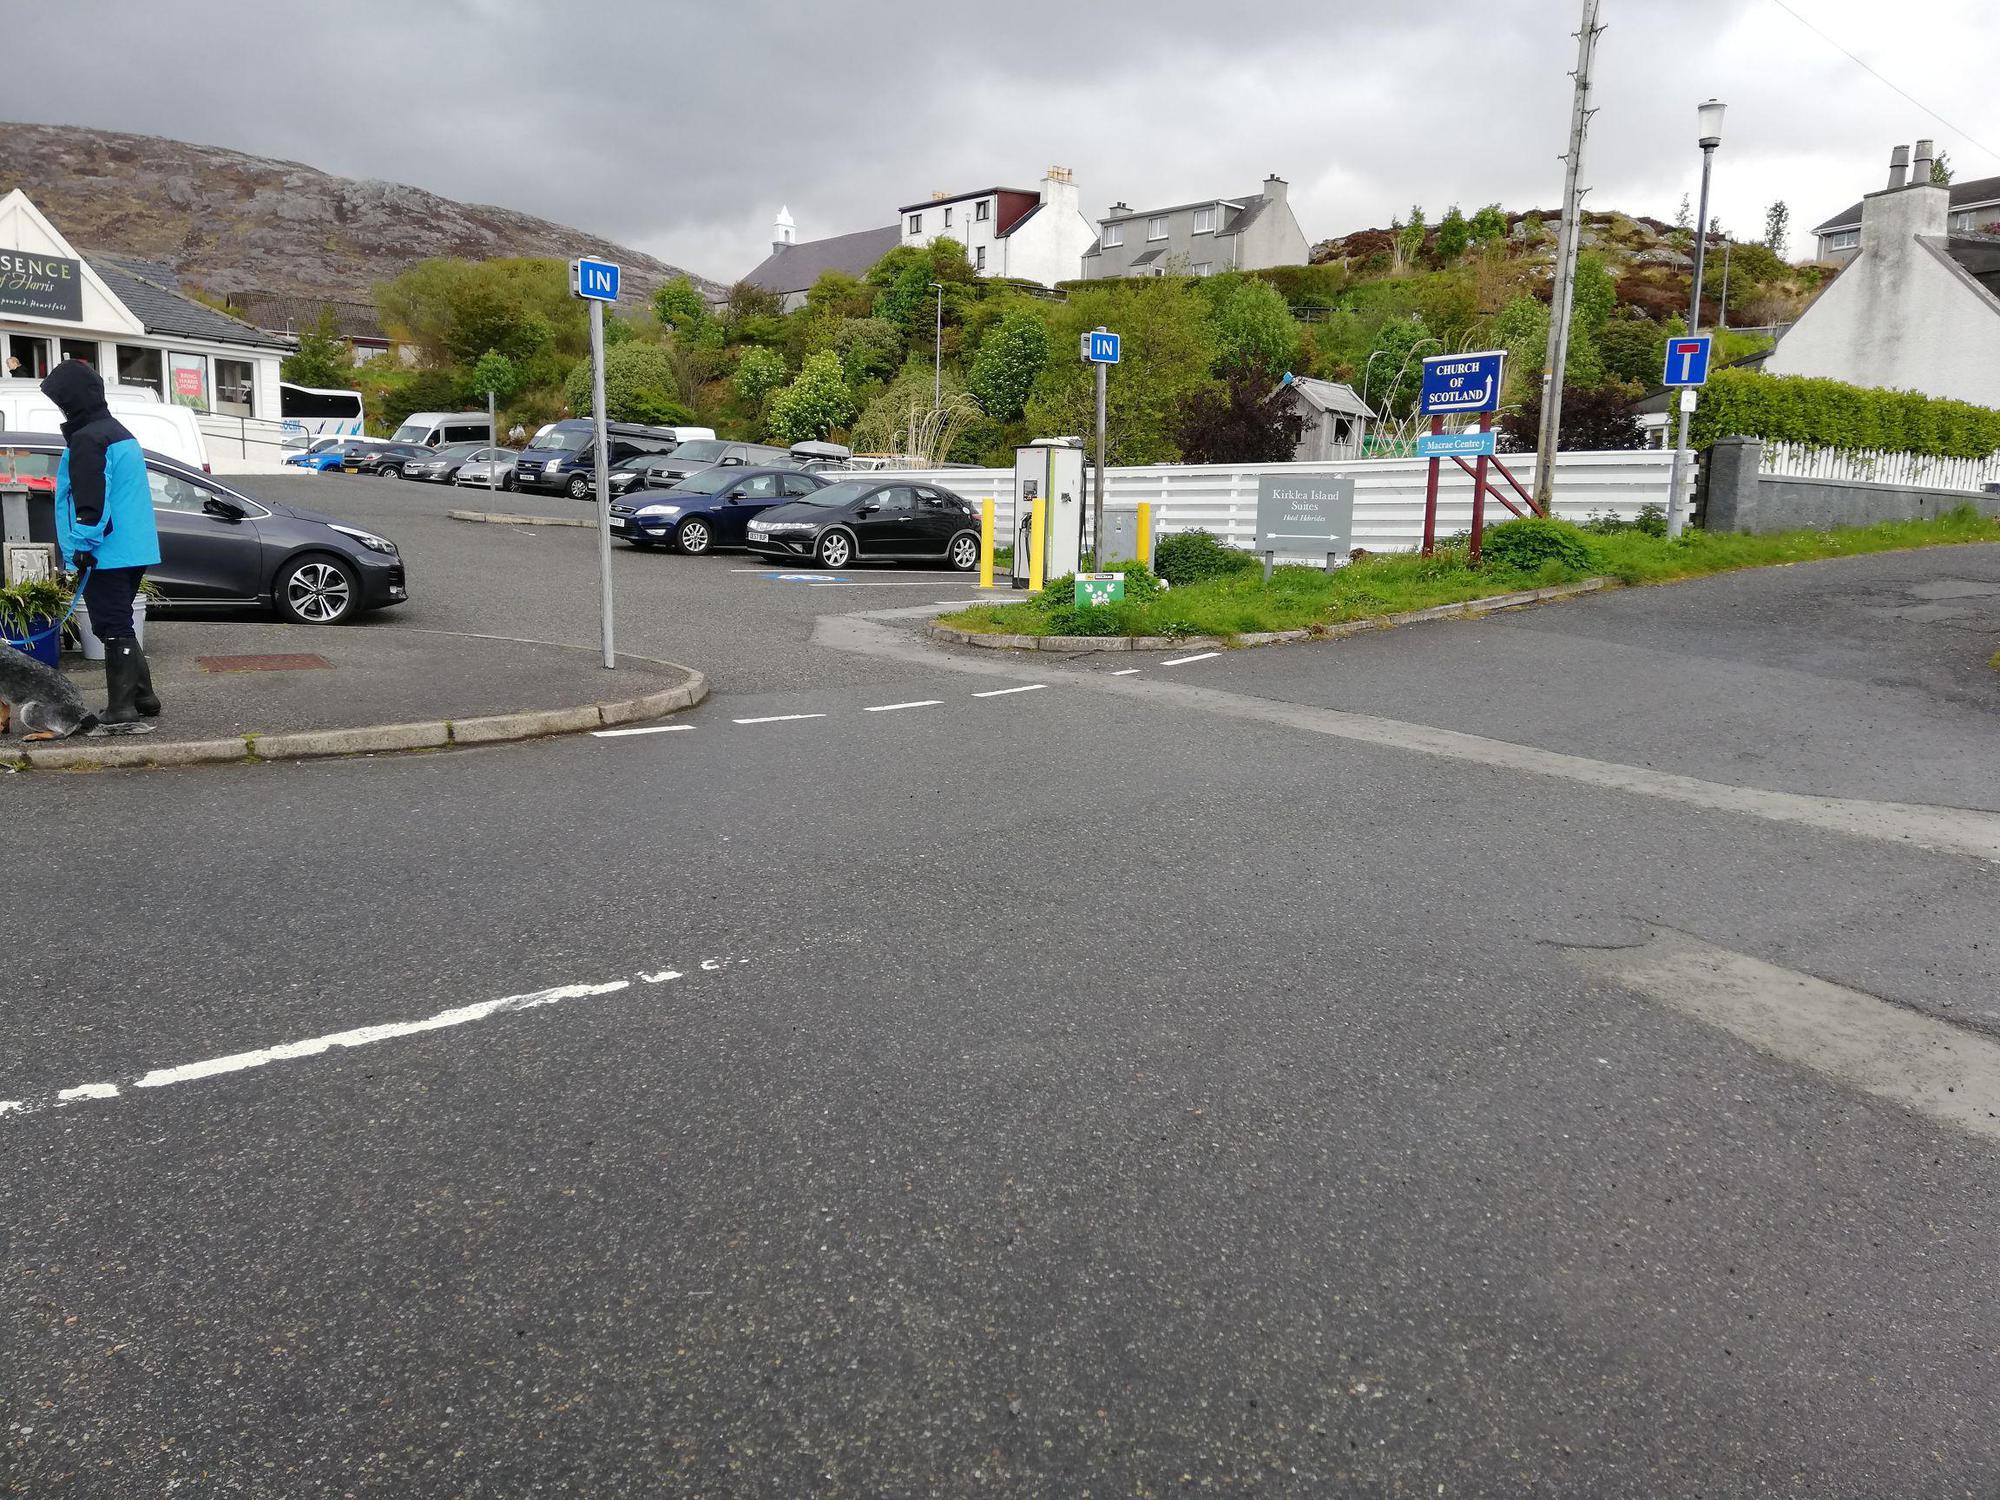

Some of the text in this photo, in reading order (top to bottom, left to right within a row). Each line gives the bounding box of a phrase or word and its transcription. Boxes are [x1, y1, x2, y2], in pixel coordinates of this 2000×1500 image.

[9, 272, 54, 292] Harris
[589, 269, 610, 292] IN
[1097, 339, 1113, 356] IN
[1436, 362, 1480, 376] CHURCH
[1449, 377, 1464, 388] OF
[1429, 389, 1483, 403] SCOTLAND
[1427, 439, 1480, 450] Macrae Centre
[1272, 489, 1339, 500] Kirklea Island
[1291, 501, 1319, 511] Suites
[1300, 514, 1326, 522] Hebrides
